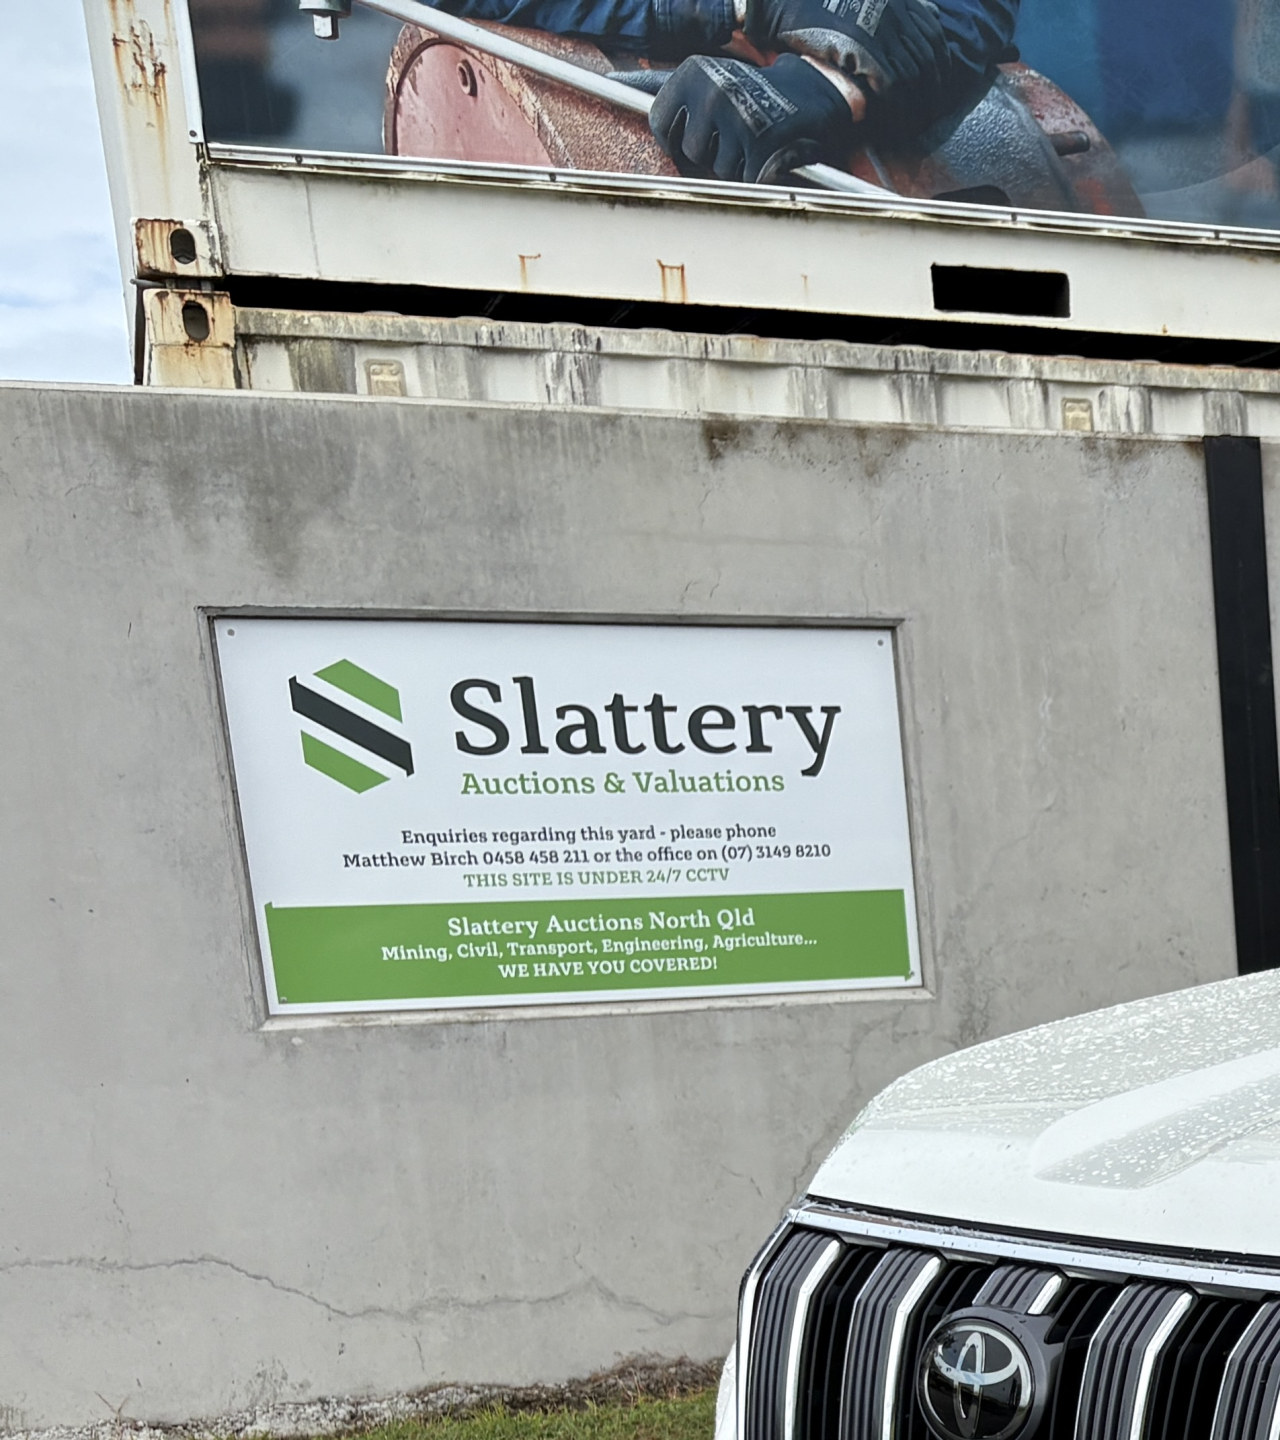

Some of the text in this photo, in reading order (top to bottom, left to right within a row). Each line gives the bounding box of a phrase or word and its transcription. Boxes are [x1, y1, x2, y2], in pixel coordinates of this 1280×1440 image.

[449, 676, 842, 777] Slattery
[459, 768, 786, 797] Auctions & Valuations
[401, 828, 488, 847] Enquiries
[491, 826, 577, 845] regarding
[580, 826, 614, 842] this
[617, 825, 656, 843] yard
[669, 825, 722, 842] please
[725, 823, 777, 841] phone
[343, 844, 832, 868] Matthew Birch 0458 458 211 or the office on (07) 3149 8210
[463, 868, 730, 888] THIS SITE IS UNDER 24/7 CCTV
[448, 908, 756, 939] Slattery Auctions North Qld
[381, 944, 453, 962] Mining,
[457, 942, 504, 959] Civil,
[506, 939, 598, 958] Transport,
[602, 936, 709, 956] Engineering,
[498, 956, 718, 978] WE HAVE YOU COVERED!
